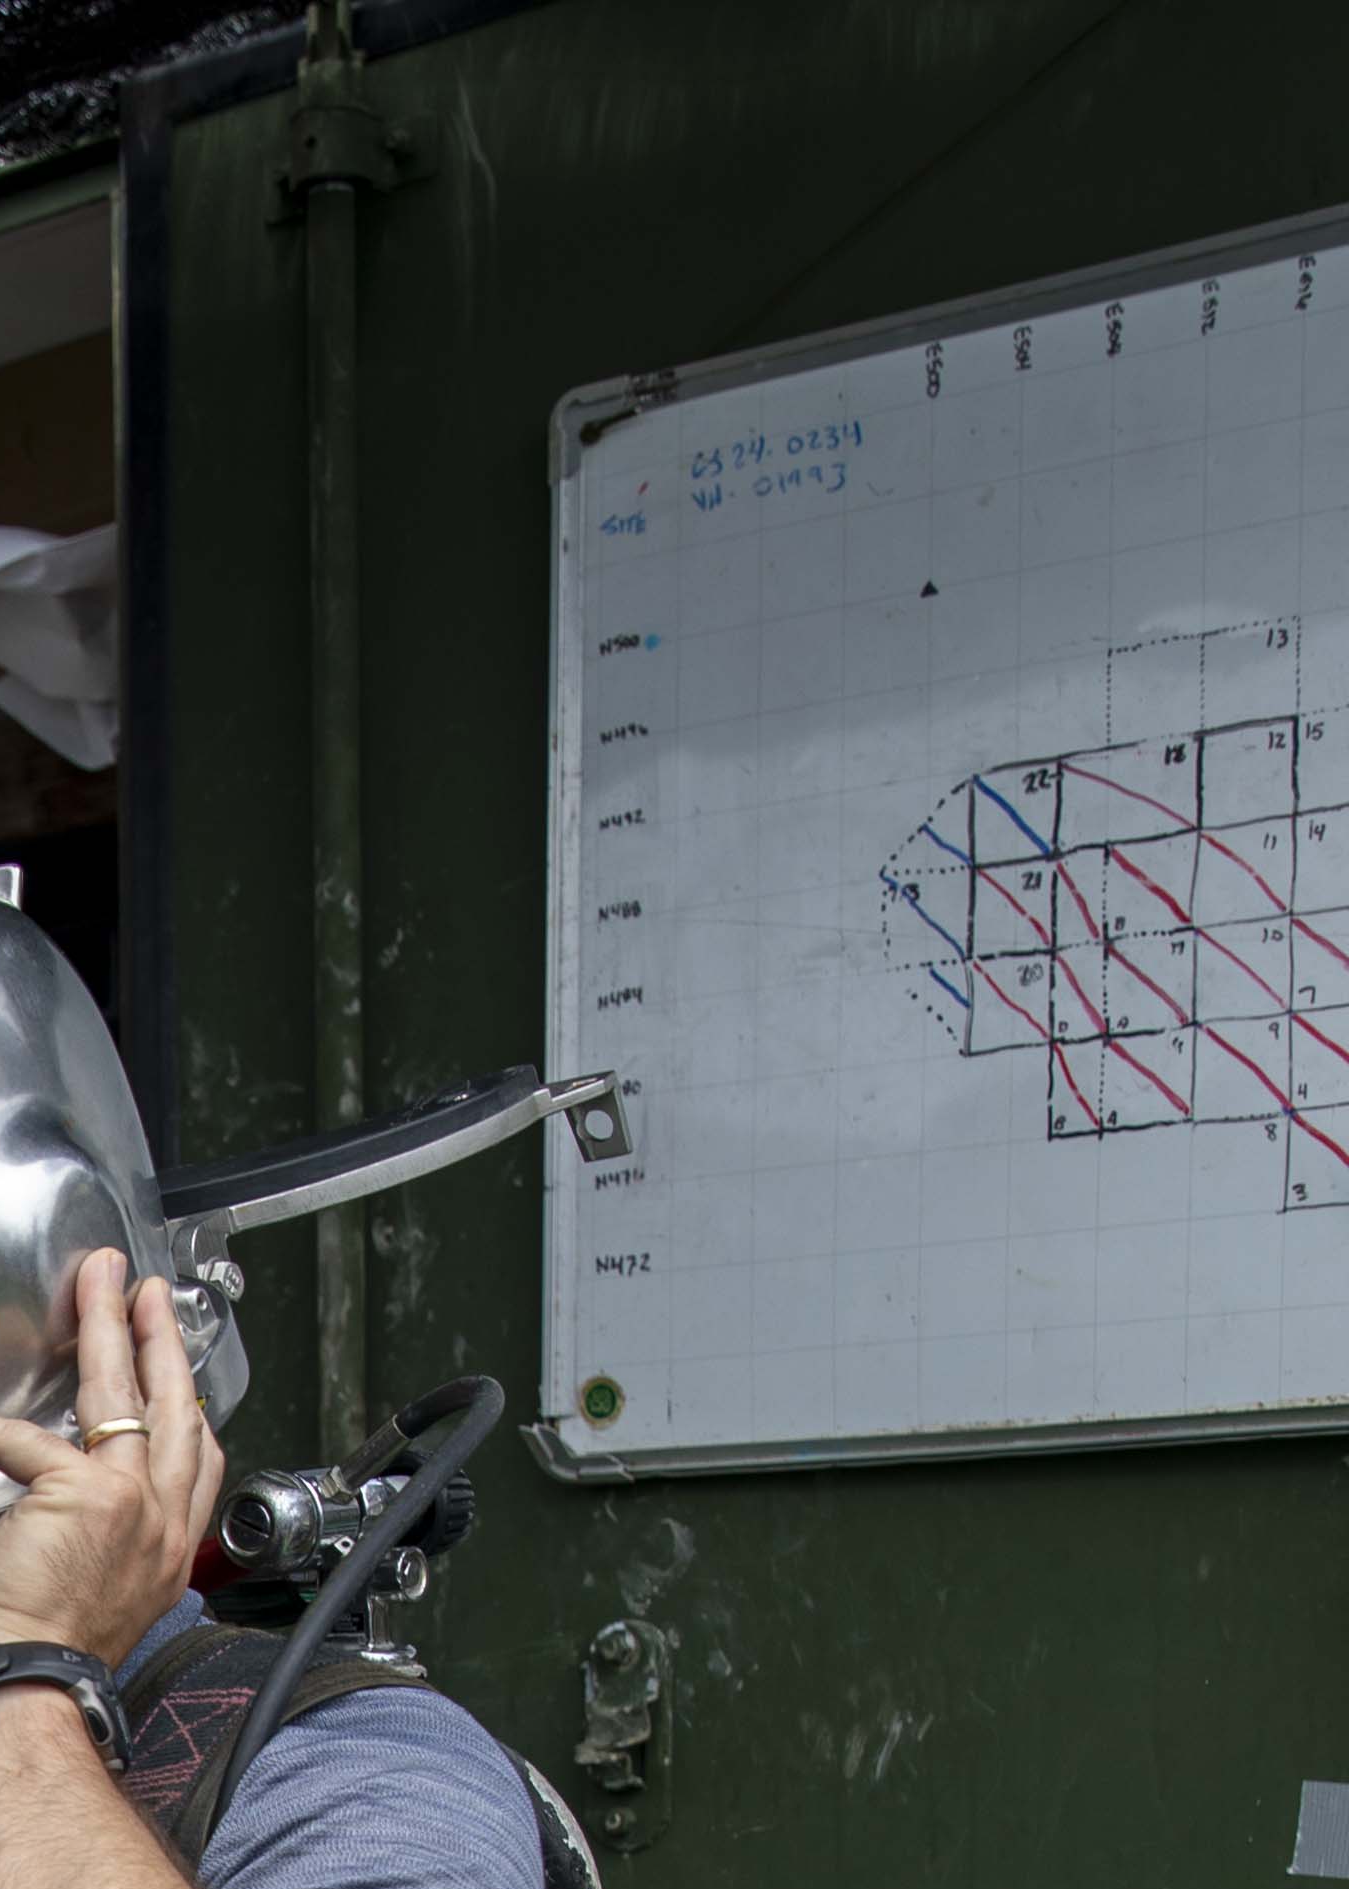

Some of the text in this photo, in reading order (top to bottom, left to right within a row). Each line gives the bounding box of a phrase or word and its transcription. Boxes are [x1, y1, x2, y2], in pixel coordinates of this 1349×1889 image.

[1013, 325, 1031, 371] E504
[925, 340, 943, 399] E500
[787, 420, 863, 455] 0234
[1266, 628, 1288, 649] 13
[1268, 731, 1286, 750] 12
[1306, 722, 1324, 741] 15
[1022, 771, 1052, 794] 22
[1308, 821, 1326, 842] 14
[1299, 986, 1316, 1005] 7
[1269, 1021, 1280, 1040] 9
[595, 1252, 651, 1278] N472
